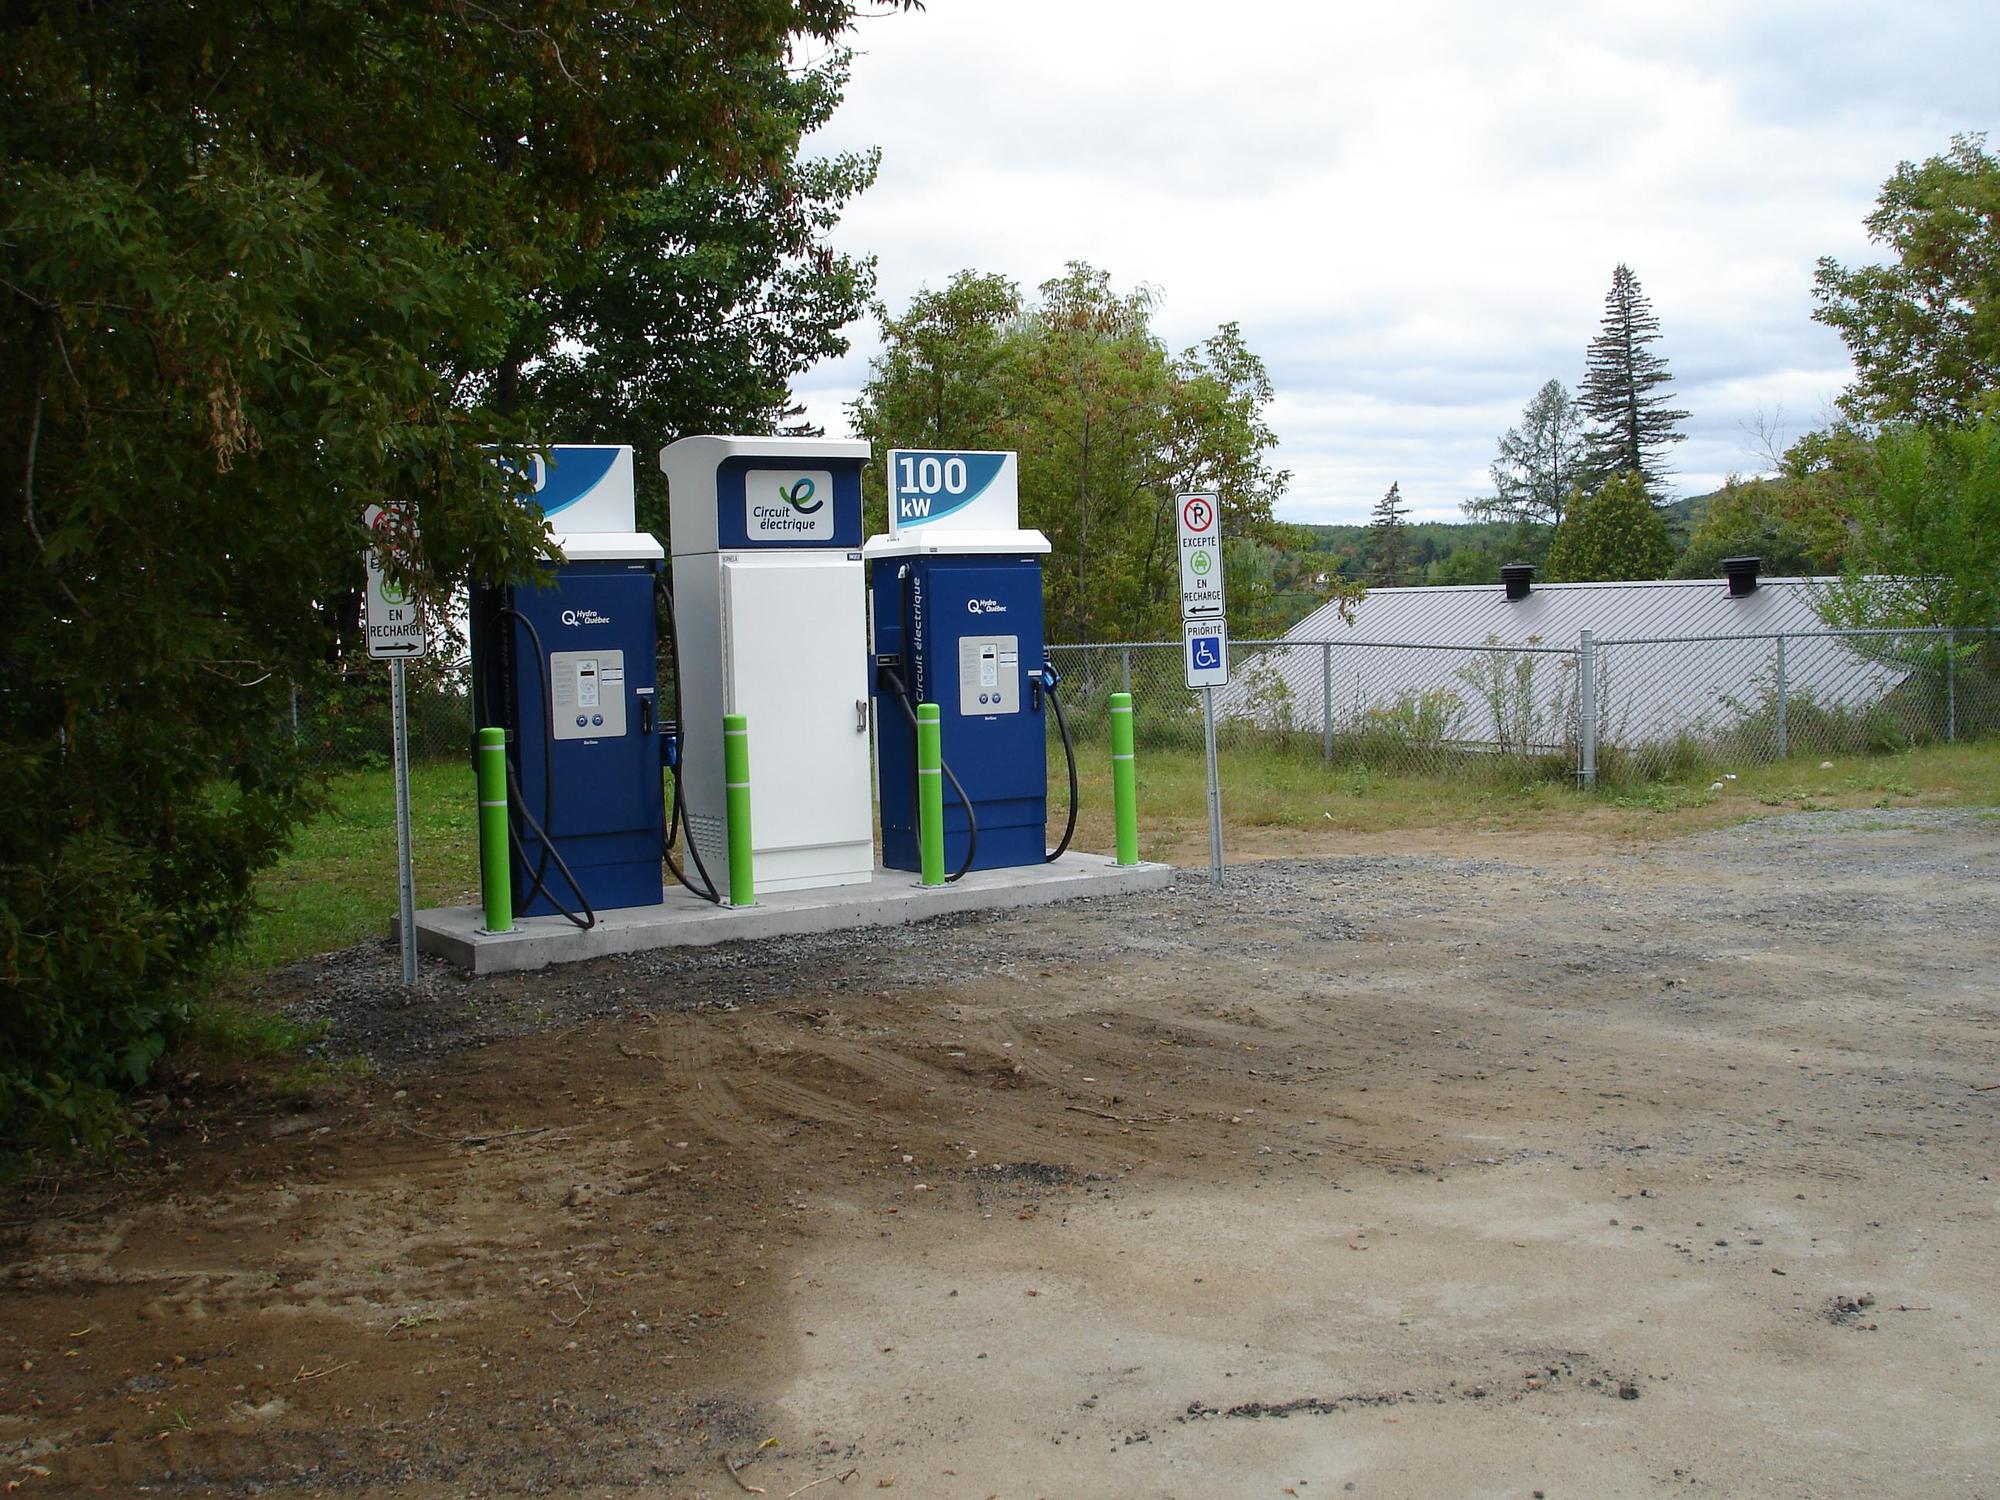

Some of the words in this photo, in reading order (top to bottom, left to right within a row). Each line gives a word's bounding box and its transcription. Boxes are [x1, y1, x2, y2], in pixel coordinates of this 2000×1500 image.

[900, 457, 967, 494] 100
[753, 506, 790, 518] Circuit
[901, 498, 931, 517] kW
[760, 517, 815, 532] électrique
[1183, 535, 1217, 548] EXCEPTÉ
[1197, 579, 1207, 589] EN
[1184, 591, 1221, 602] RECHARGE
[389, 610, 403, 621] EN
[577, 610, 598, 618] Hydro
[913, 577, 923, 650] électrique
[584, 616, 610, 624] Québec
[1187, 625, 1223, 636] PRIORITÉ
[915, 654, 924, 702] Circuit
